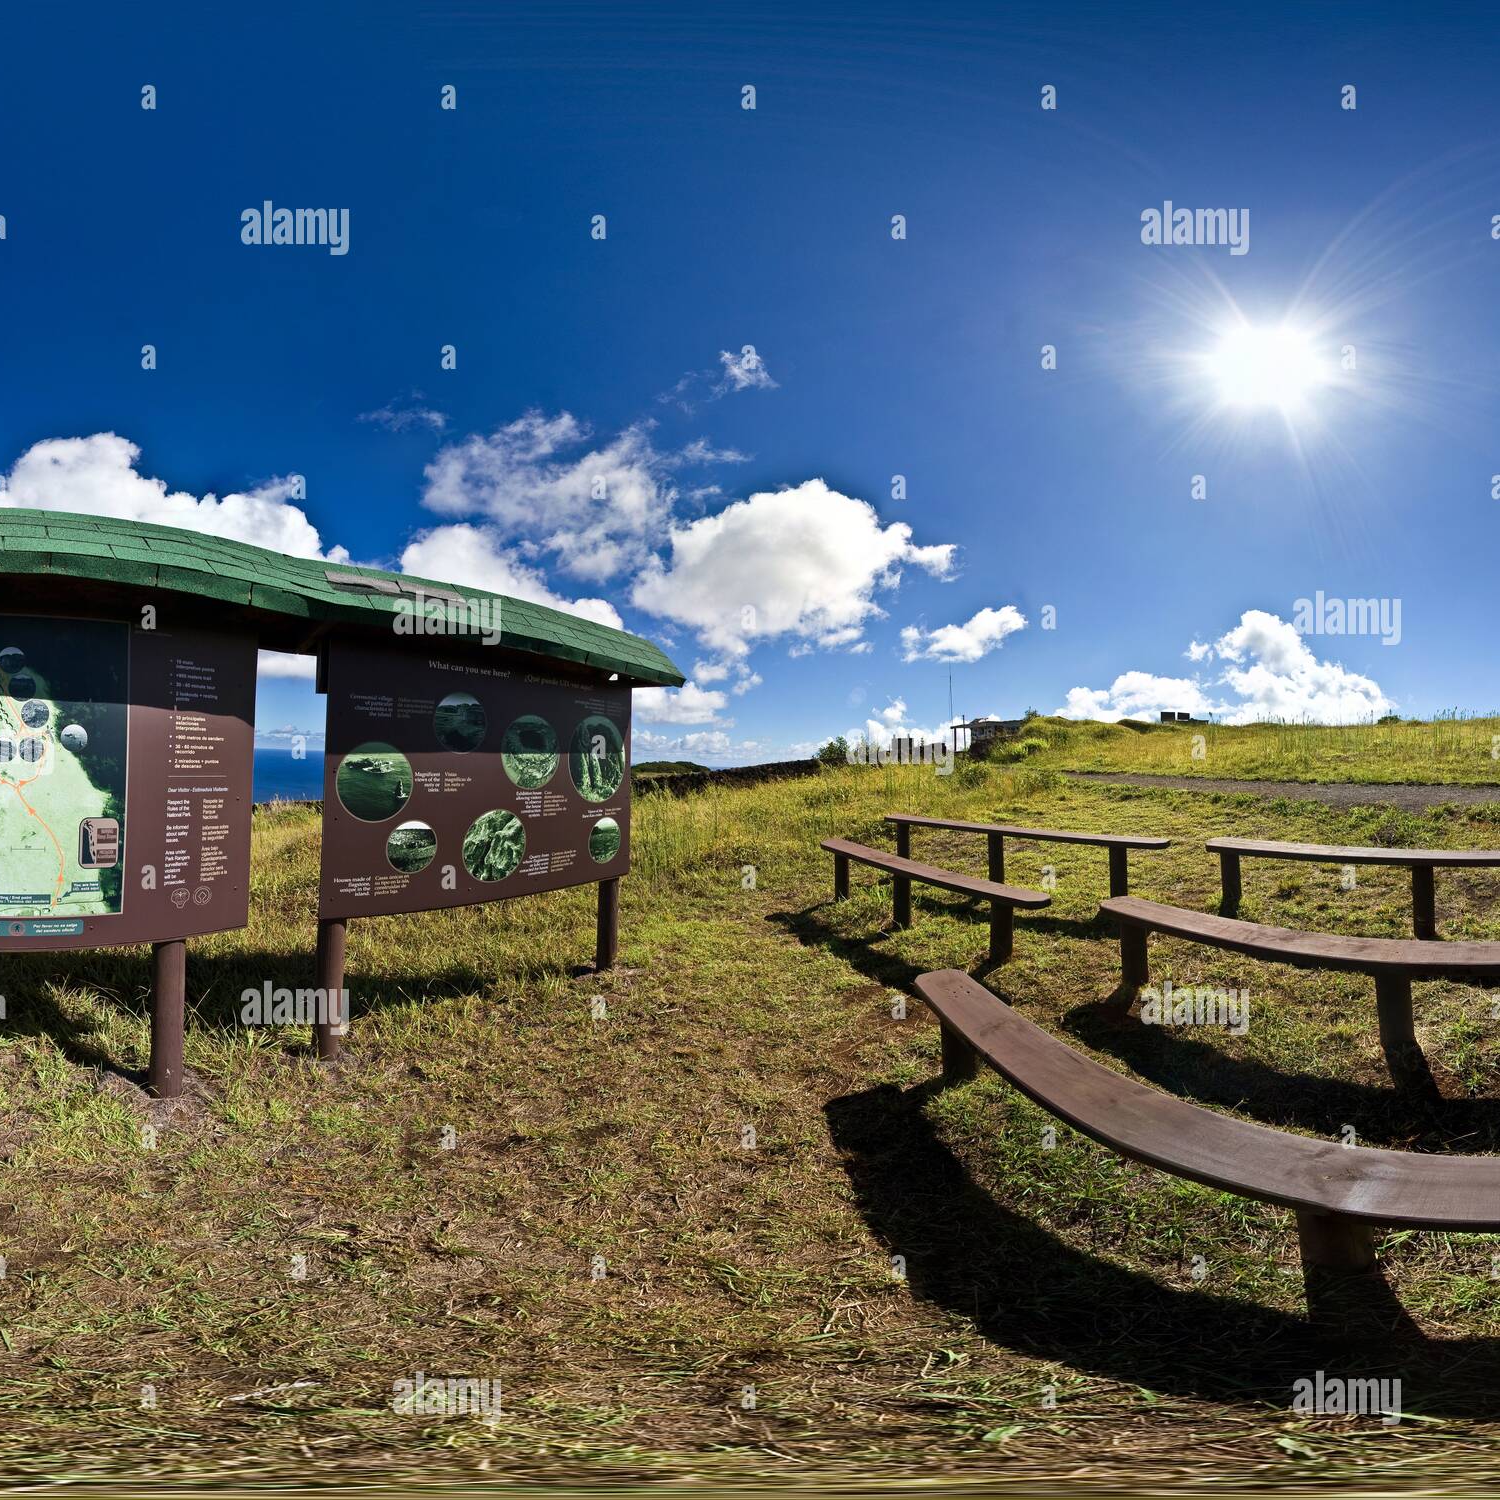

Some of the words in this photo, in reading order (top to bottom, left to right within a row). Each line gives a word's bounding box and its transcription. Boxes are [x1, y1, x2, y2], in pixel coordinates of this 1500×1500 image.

[428, 660, 449, 669] What
[451, 664, 463, 672] can
[464, 665, 478, 674] you
[480, 667, 491, 675] see
[493, 669, 511, 678] here?
[524, 673, 538, 684] ¿Qué
